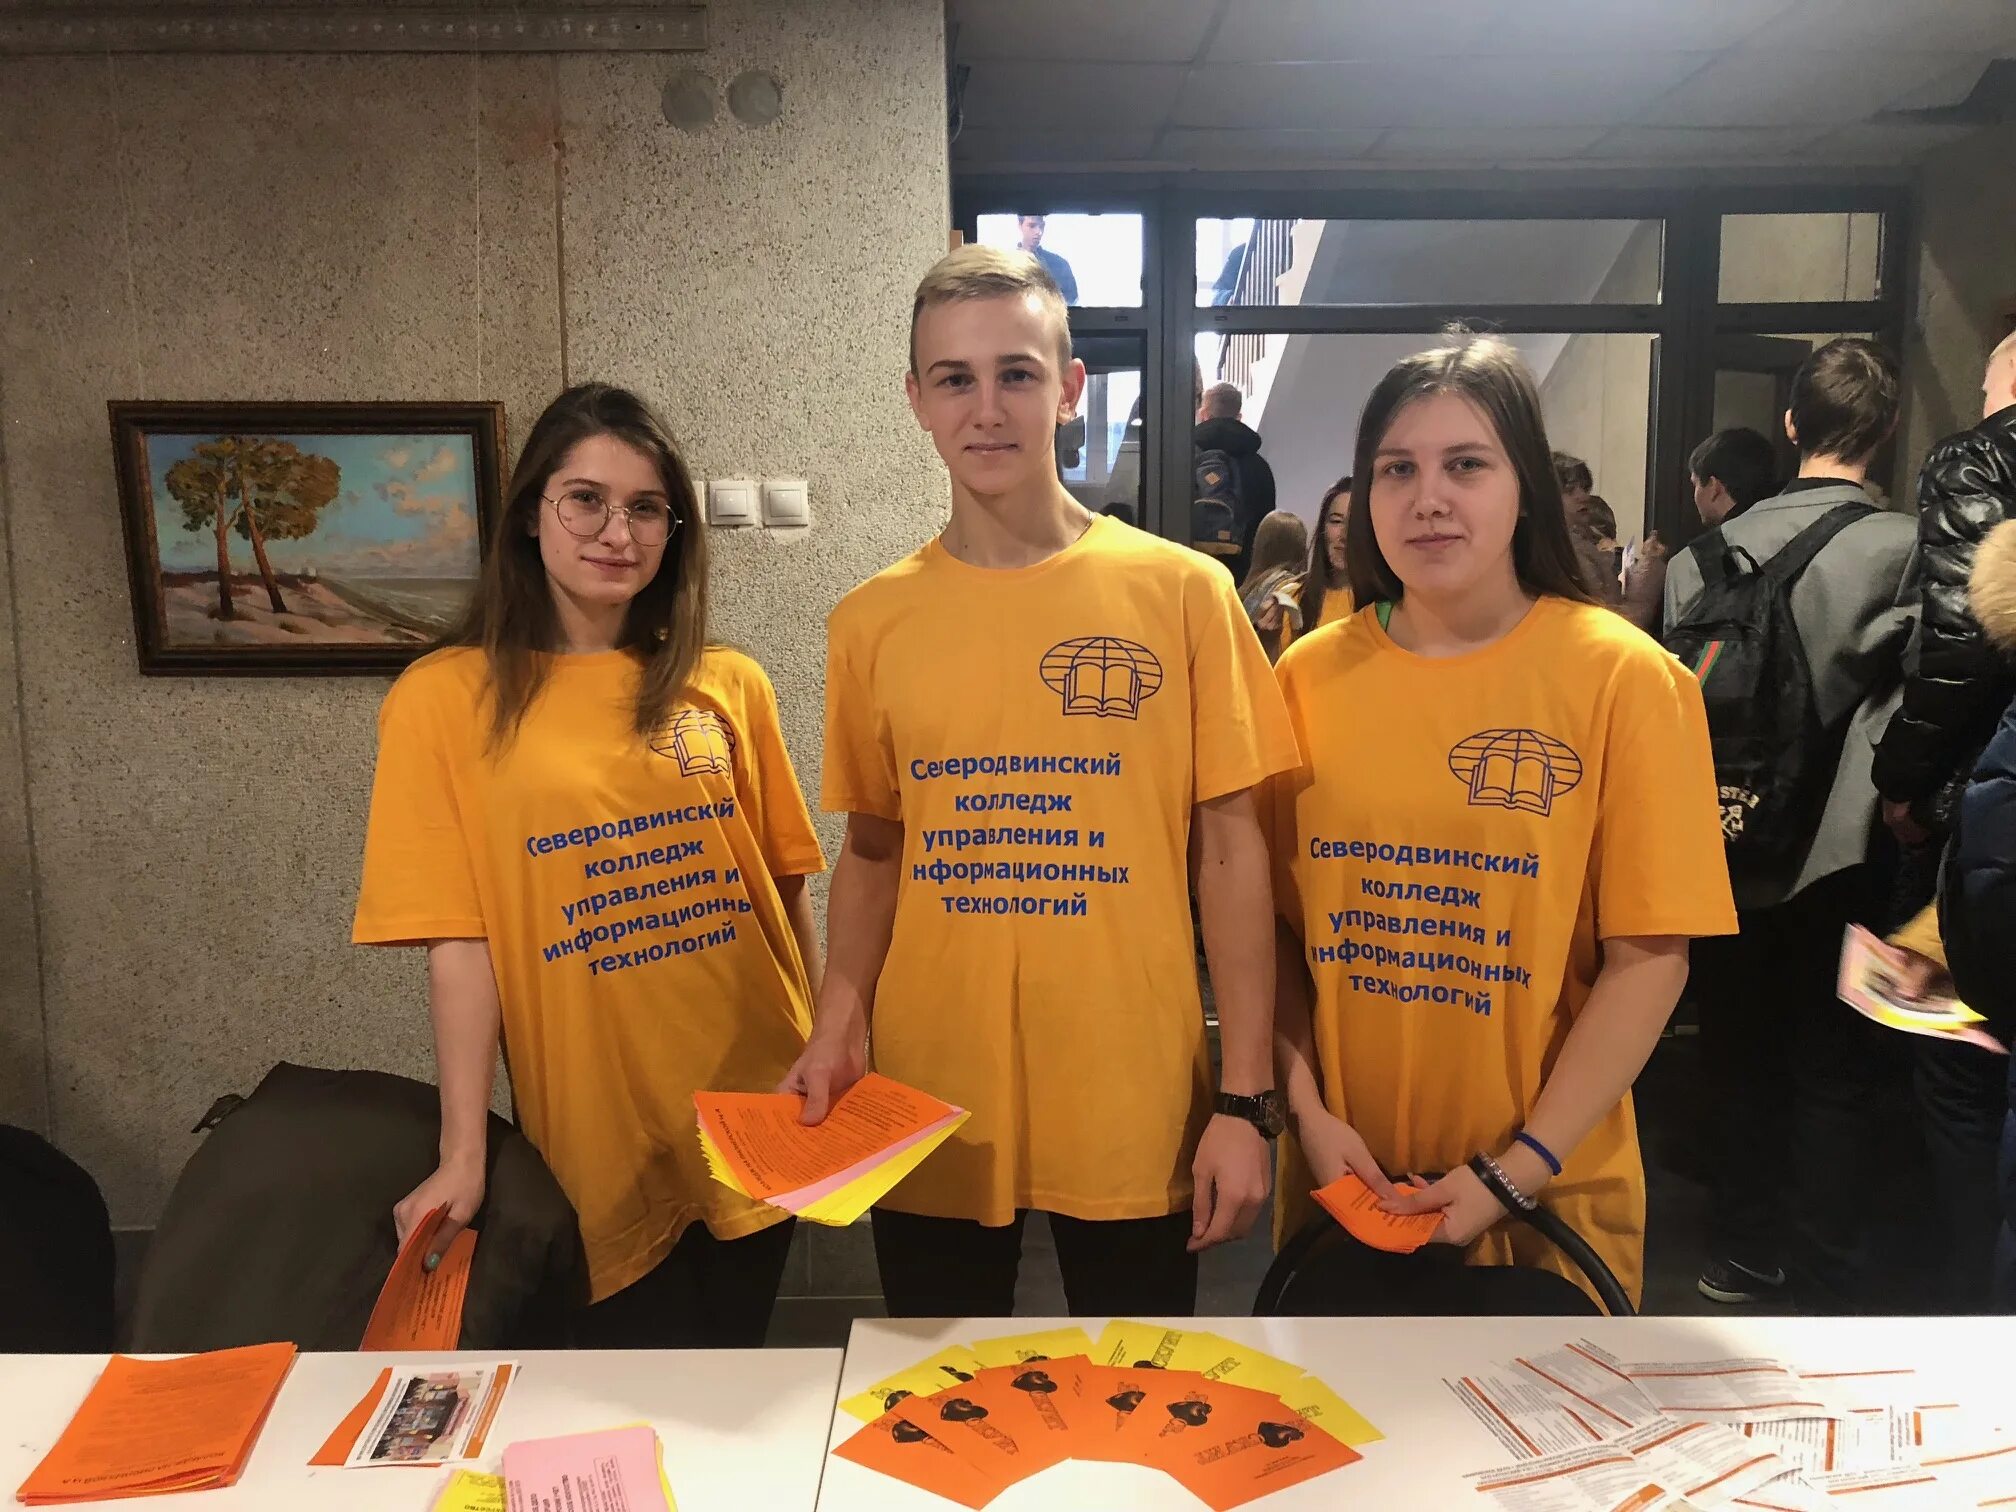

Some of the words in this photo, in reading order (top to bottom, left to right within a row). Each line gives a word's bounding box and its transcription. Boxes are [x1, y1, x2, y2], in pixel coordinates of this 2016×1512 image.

[955, 793, 1072, 815] колледж
[922, 827, 1079, 852] управления
[1089, 832, 1105, 848] и
[1310, 837, 1540, 879] Северодвинский
[584, 840, 704, 879] колледж
[910, 858, 1129, 885] нформационных
[561, 869, 717, 926] управления
[725, 867, 740, 884] и
[942, 892, 1088, 917] технологий
[1361, 879, 1481, 909] колледж
[1328, 909, 1486, 945] управления
[1496, 930, 1512, 946] и
[588, 921, 737, 976] технологий
[1349, 974, 1492, 1017] технологий
